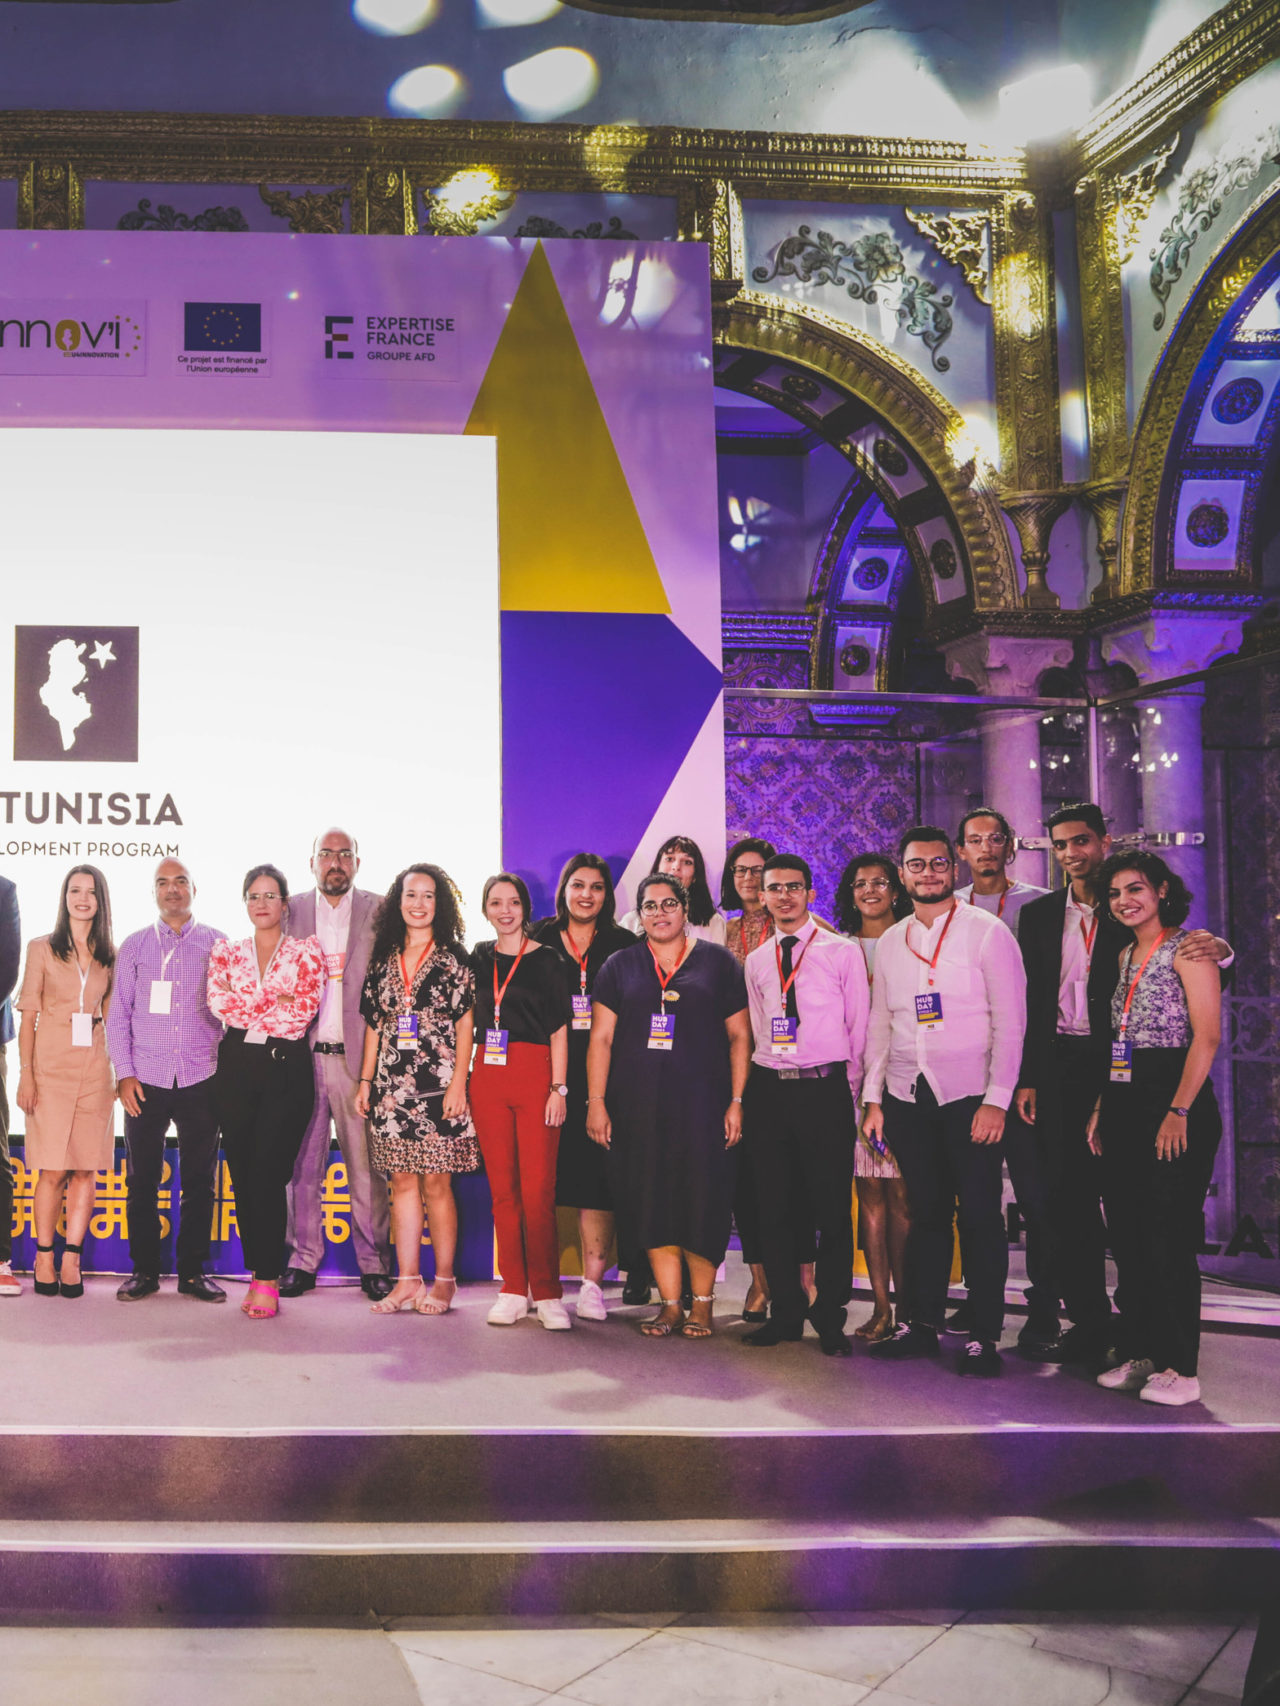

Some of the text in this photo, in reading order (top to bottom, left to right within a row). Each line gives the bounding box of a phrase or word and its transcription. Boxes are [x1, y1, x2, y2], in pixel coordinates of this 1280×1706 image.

[366, 316, 455, 331] EXPERTISE
[366, 332, 435, 346] FRANCE
[190, 356, 211, 364] projet
[367, 351, 435, 361] GROUPE AFD
[214, 366, 258, 374] européenne
[0, 791, 183, 826] TUNISIA
[88, 841, 180, 857] PROGRAM
